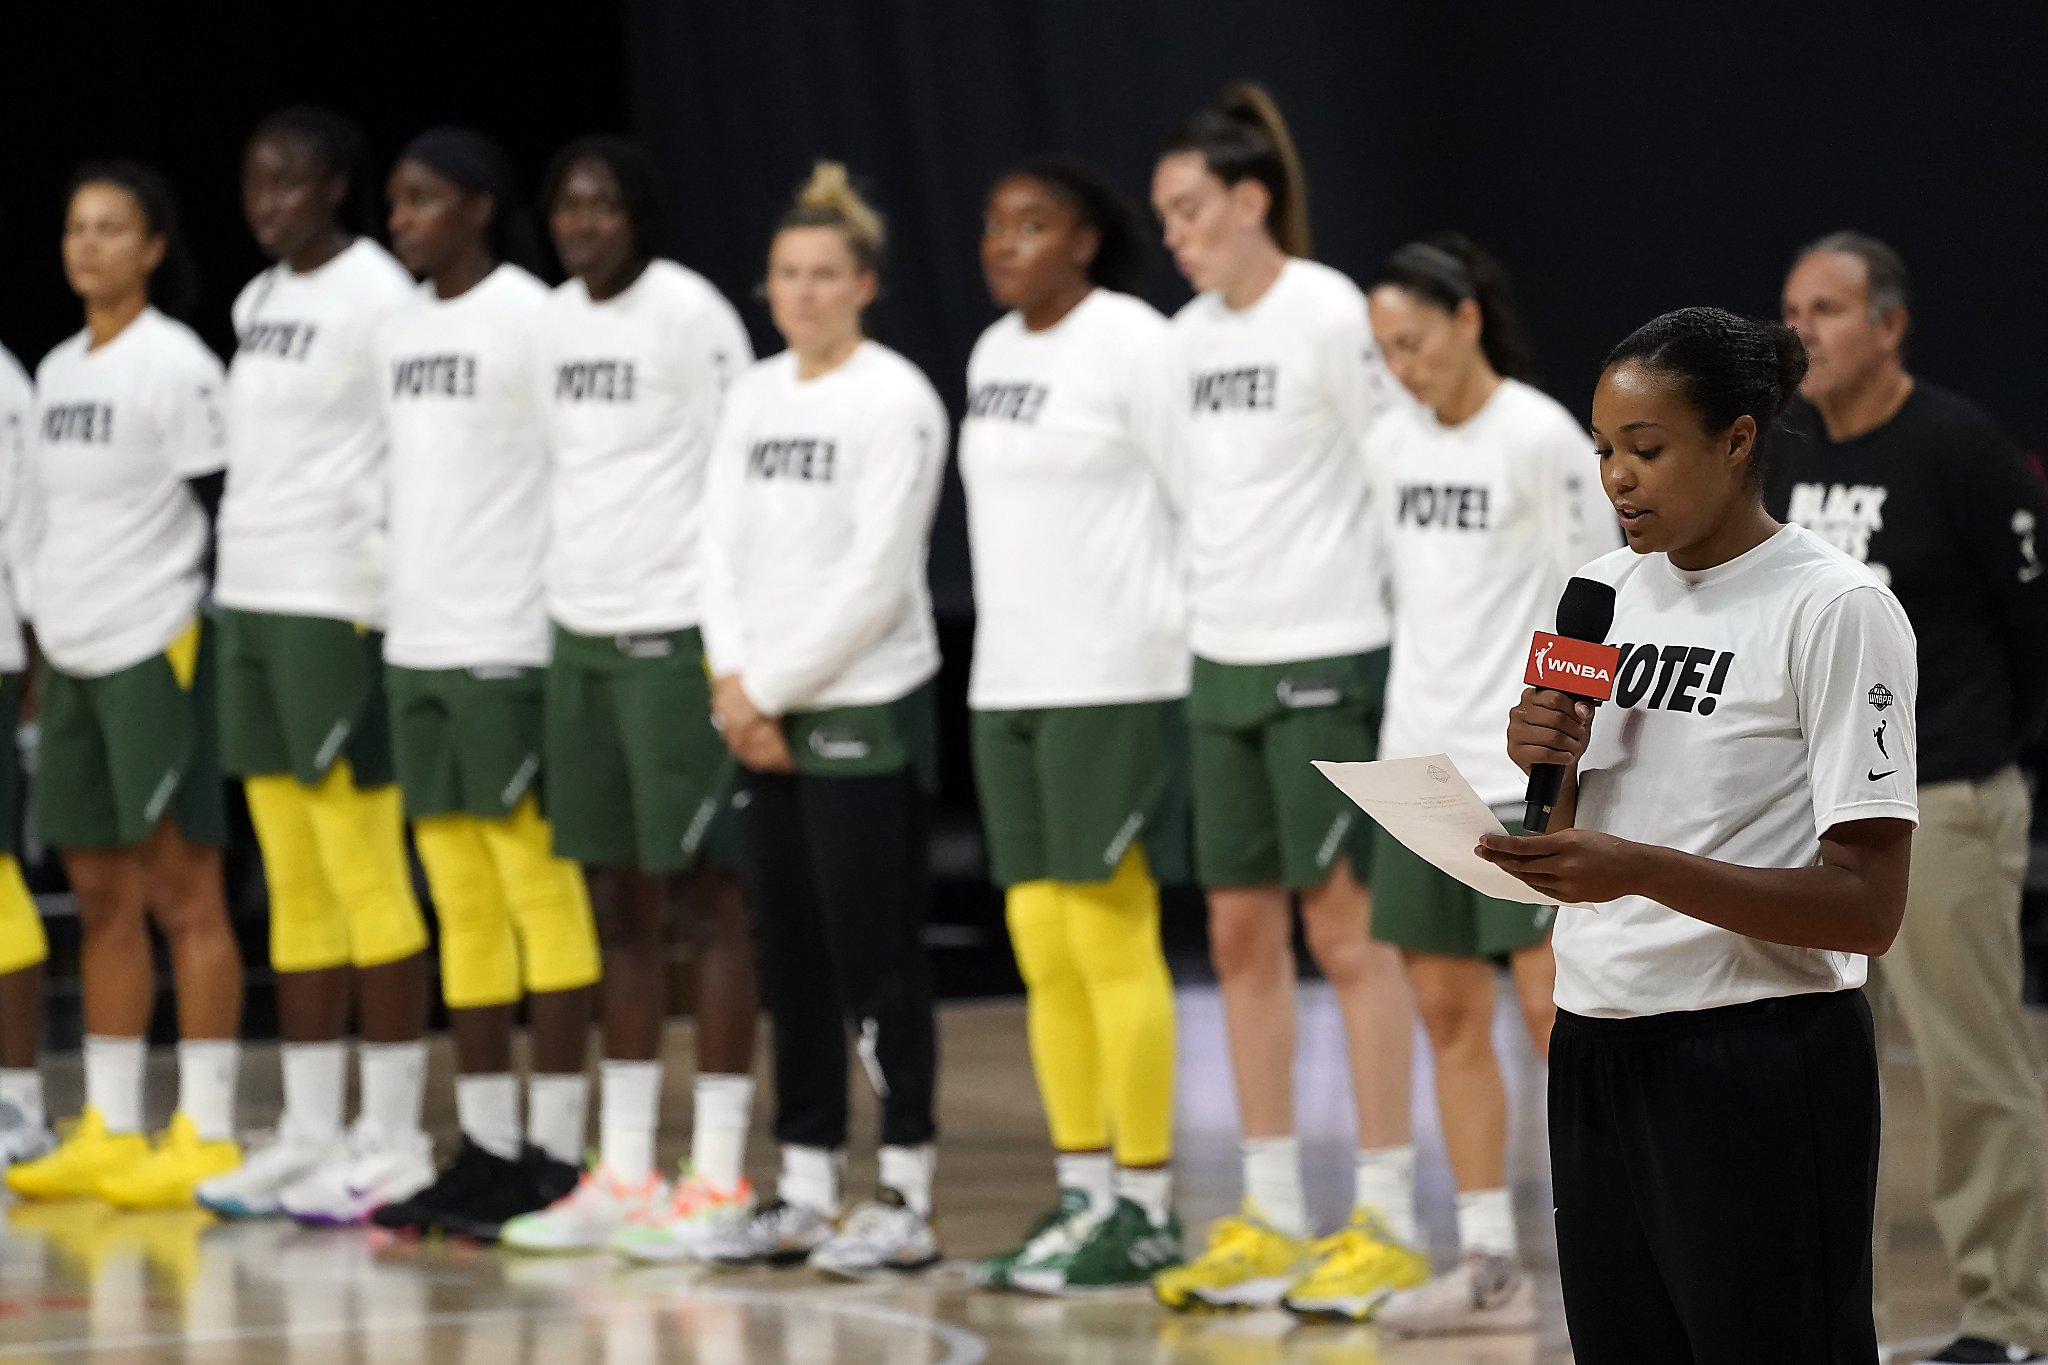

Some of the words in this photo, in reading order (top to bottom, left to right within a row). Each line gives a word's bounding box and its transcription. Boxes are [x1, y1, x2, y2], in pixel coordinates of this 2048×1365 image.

[391, 353, 476, 399] VOTE!
[554, 359, 635, 402] VOTE!
[1190, 362, 1277, 412] VOTE!
[747, 437, 837, 482] VOTE!
[1397, 483, 1490, 530] VOTE!
[1547, 657, 1610, 682] WNBA
[1602, 642, 1736, 717] OTE!
[1869, 692, 1892, 705] WNBPA
